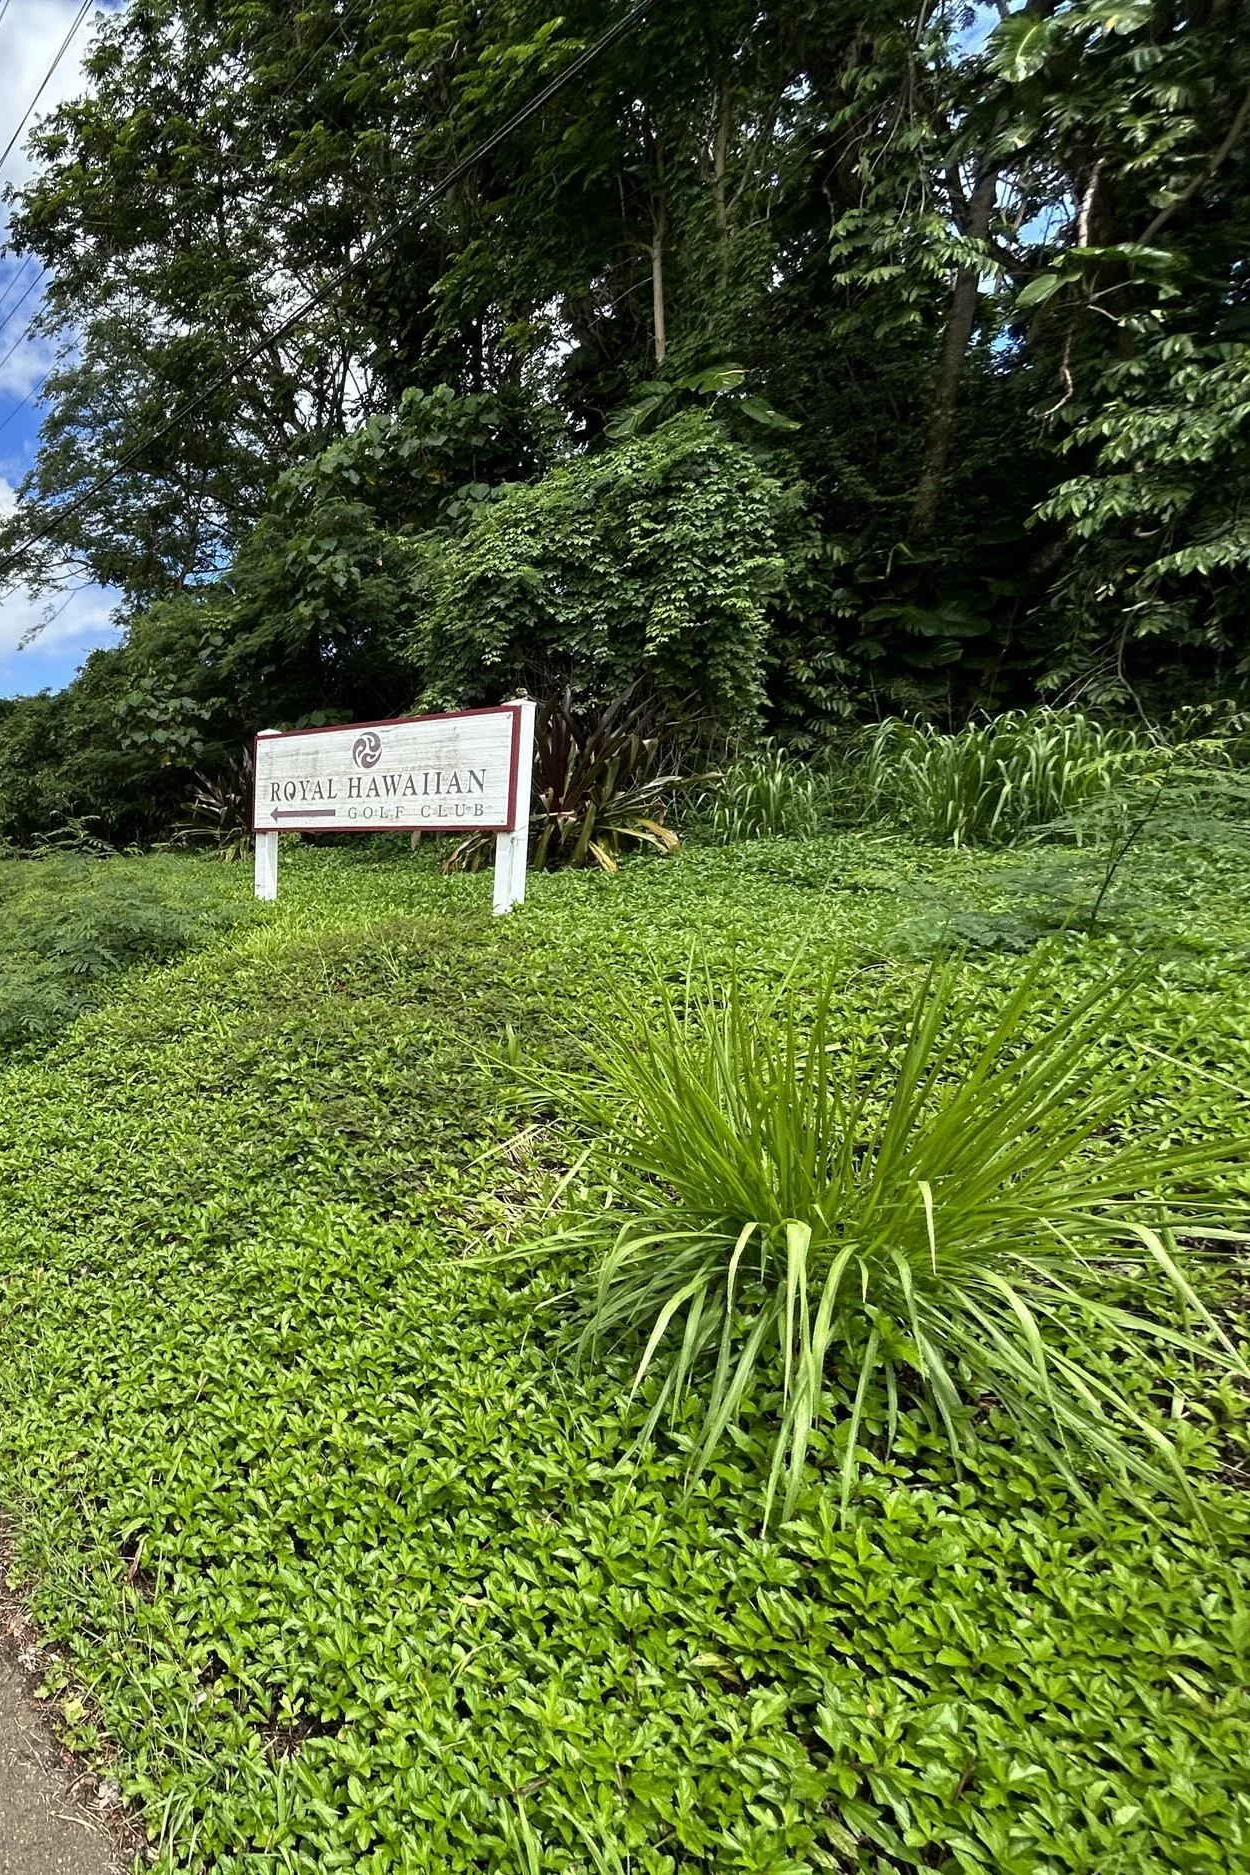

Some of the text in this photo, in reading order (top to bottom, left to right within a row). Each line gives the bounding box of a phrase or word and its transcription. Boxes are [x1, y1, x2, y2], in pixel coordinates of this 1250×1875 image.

[270, 768, 487, 802] ROYAL HAWAIIAN
[348, 803, 484, 819] GOLF CLUB
